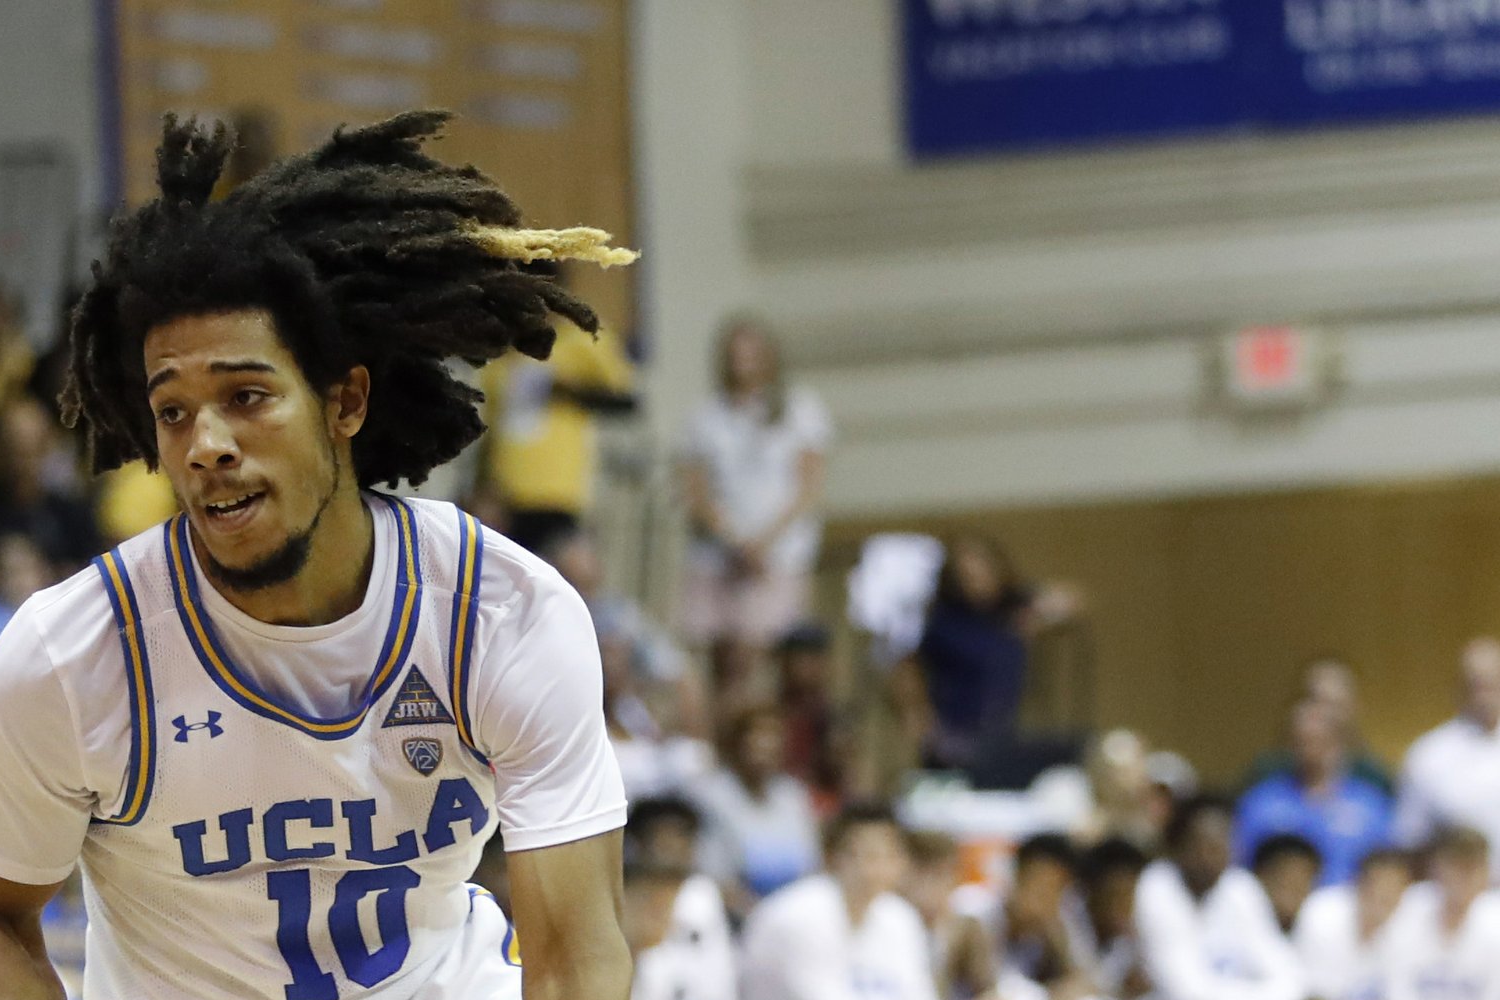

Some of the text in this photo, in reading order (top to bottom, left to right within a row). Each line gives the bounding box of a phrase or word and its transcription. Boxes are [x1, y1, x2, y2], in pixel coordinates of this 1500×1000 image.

[394, 702, 439, 719] JRW
[404, 740, 441, 763] PAC
[414, 755, 434, 770] 12
[172, 777, 489, 877] UCLA
